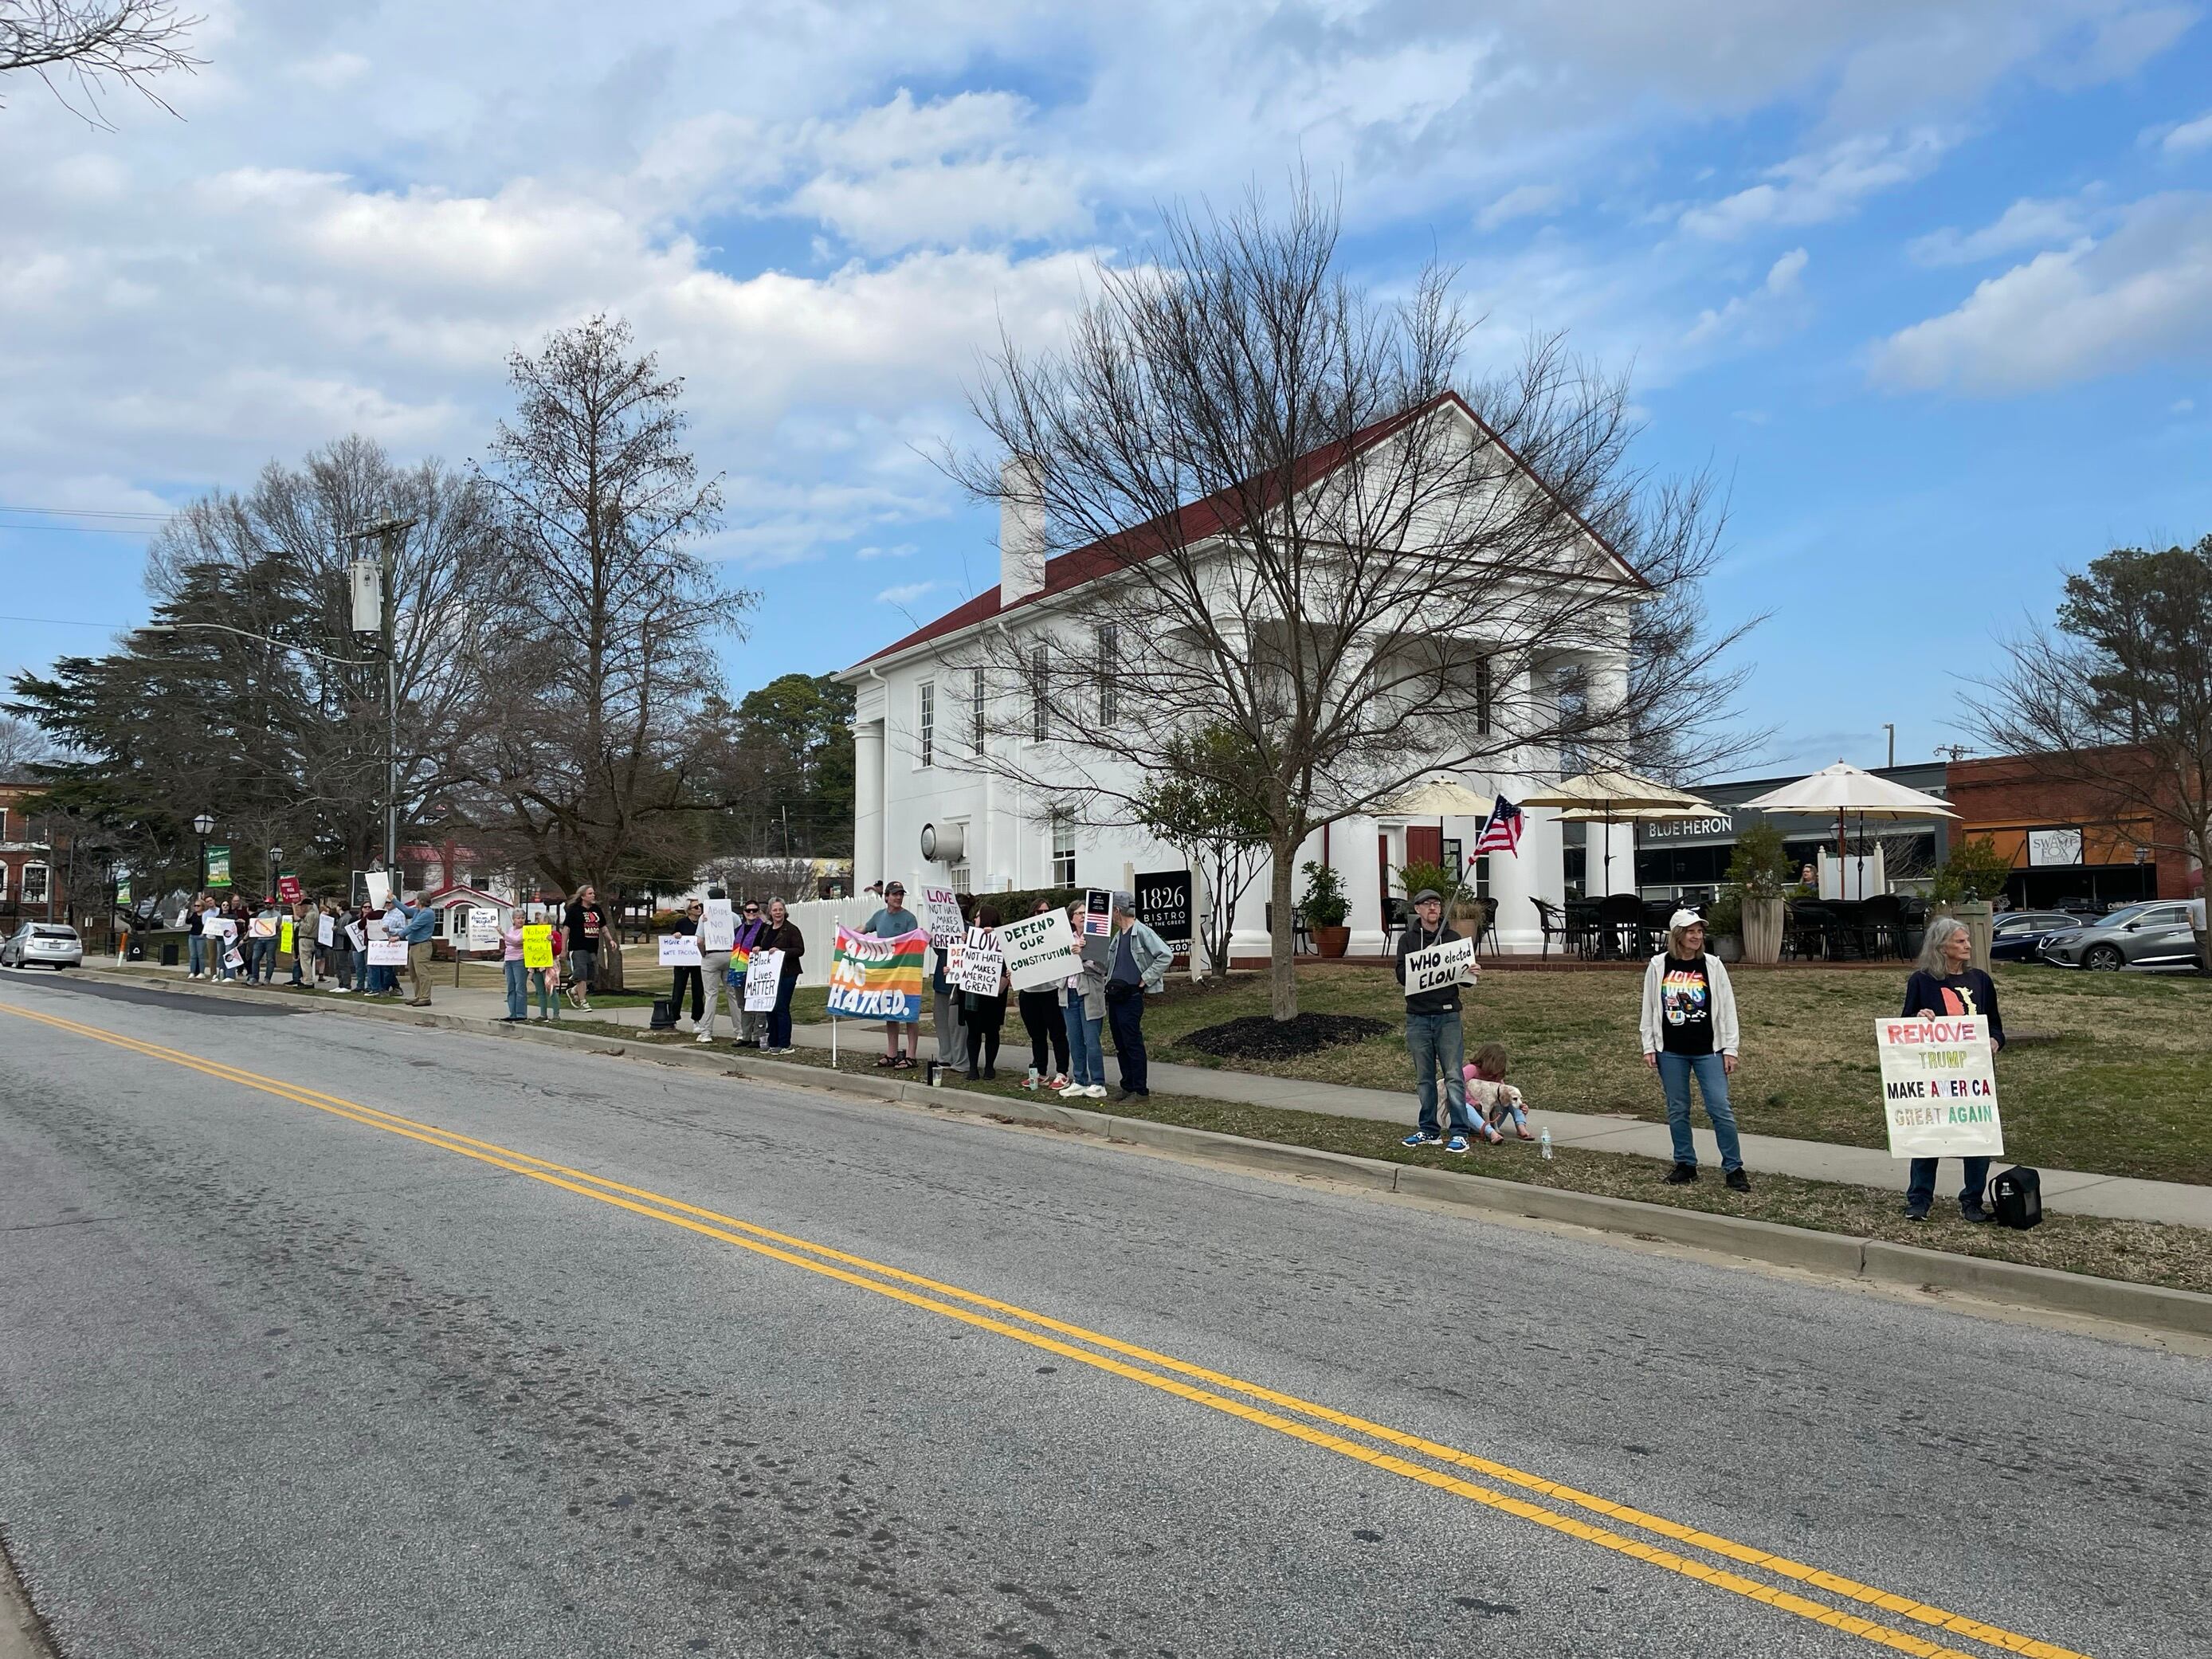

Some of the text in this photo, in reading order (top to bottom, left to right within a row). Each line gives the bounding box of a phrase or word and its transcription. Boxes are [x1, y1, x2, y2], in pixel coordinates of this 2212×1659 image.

[1649, 818, 1732, 837] BLUE HERON
[2034, 832, 2079, 849] SWAMP
[927, 889, 955, 904] LOVE
[1140, 885, 1185, 910] 1826
[708, 906, 730, 916] ABIDE
[928, 904, 959, 915] NOT HATE
[1143, 911, 1185, 922] BISTRO
[931, 923, 961, 933] AMERICA
[936, 916, 959, 924] MAKES
[1004, 917, 1055, 943] DEFEND
[708, 932, 732, 947] HATE!
[1019, 935, 1045, 951] OUR
[749, 954, 771, 967] #Black
[966, 951, 1003, 964] NOT HATE
[1010, 945, 1072, 971] CONSTITUTION
[1410, 943, 1472, 972] WHO elected
[754, 967, 772, 980] Lives
[835, 957, 866, 986] NO
[949, 972, 959, 981] TO
[962, 971, 997, 983] AMERICA
[972, 963, 996, 975] MAKES
[965, 980, 994, 993] GREAT
[1419, 967, 1456, 990] ELON
[745, 980, 775, 996] MATTER
[827, 982, 910, 1016] HATRED.
[1887, 1022, 1976, 1044] REMOVE
[1919, 1050, 1967, 1069] TRUMP
[1887, 1081, 1925, 1099] MAKE
[1895, 1105, 1993, 1125] GREAT AGAIN
